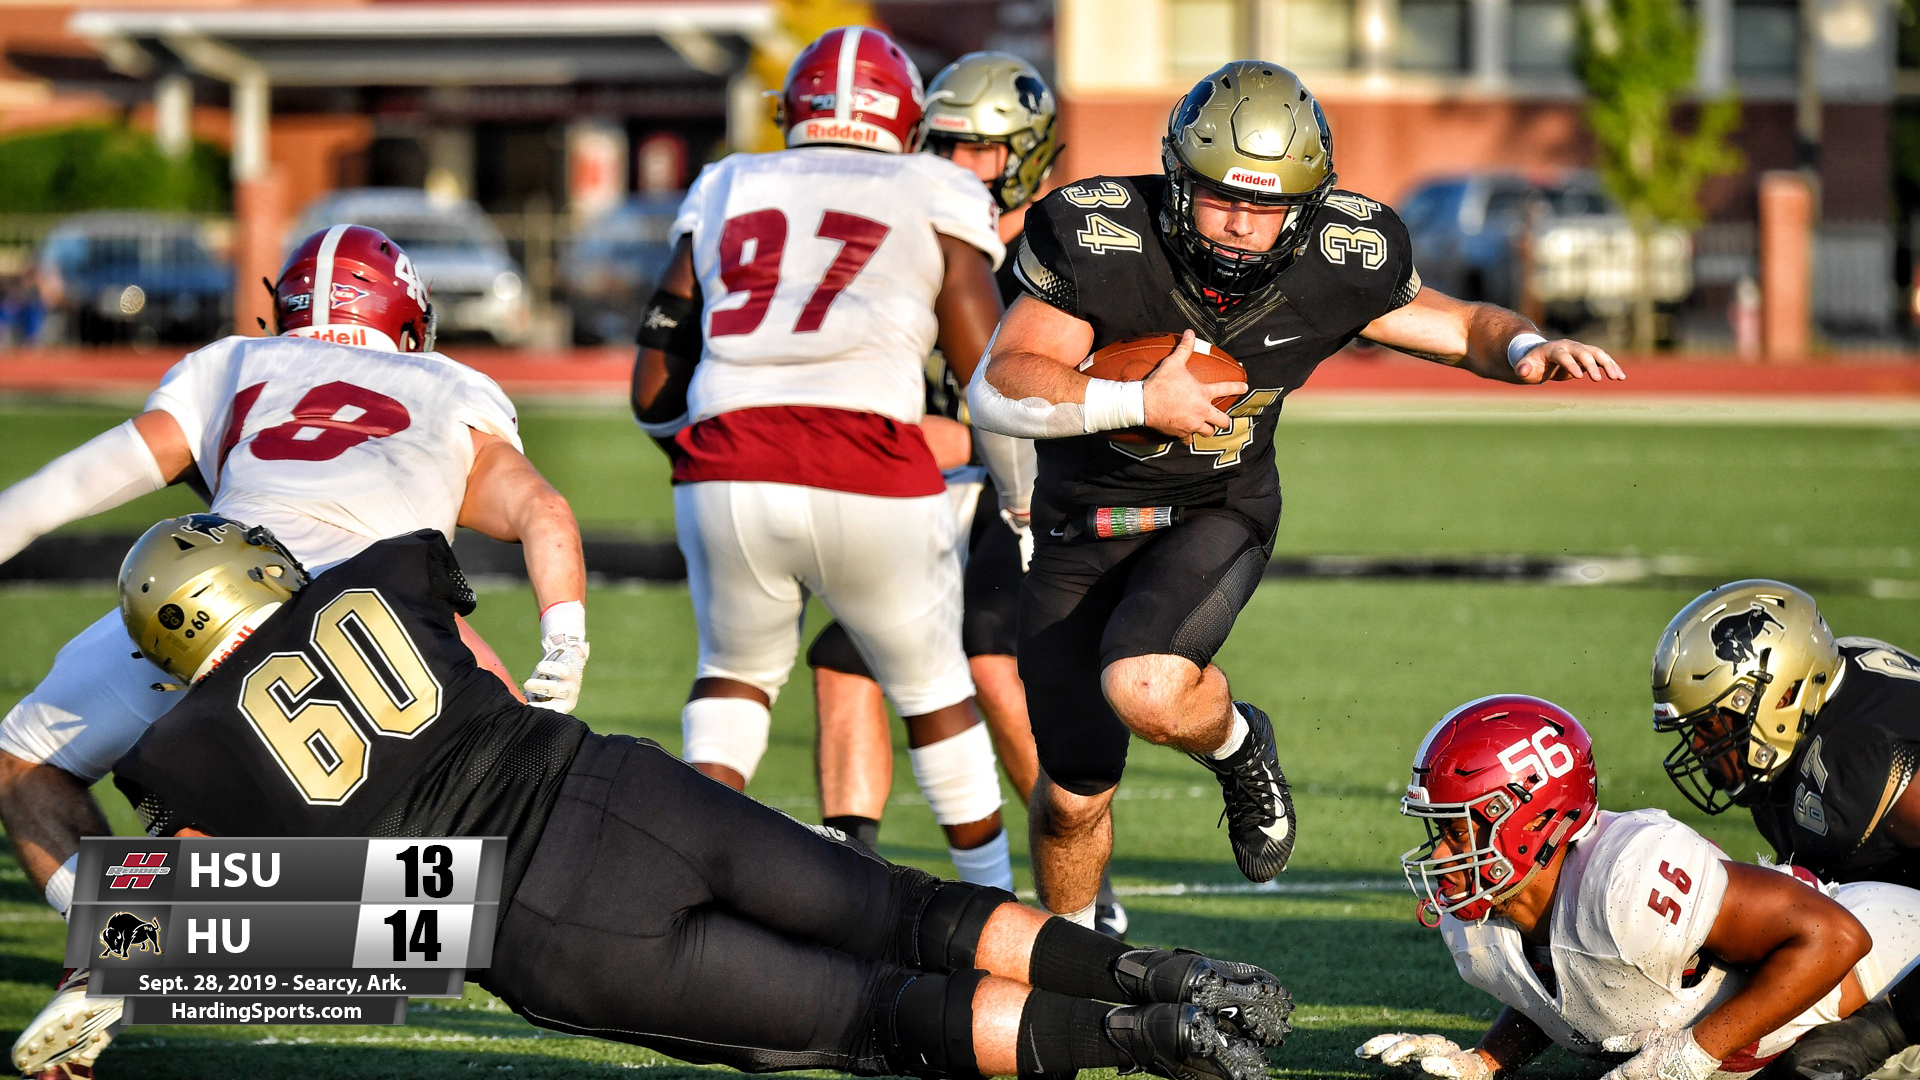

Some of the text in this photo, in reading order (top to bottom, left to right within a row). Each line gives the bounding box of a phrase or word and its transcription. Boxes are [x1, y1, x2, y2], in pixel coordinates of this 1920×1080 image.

[806, 124, 878, 144] Riddell
[1231, 173, 1276, 187] Riddell
[1061, 181, 1143, 255] 34
[1319, 191, 1388, 271] 34
[709, 208, 892, 338] 97
[1109, 386, 1285, 470] 4
[191, 610, 210, 631] 60
[237, 587, 443, 807] 60
[1496, 725, 1575, 793] 56
[1793, 734, 1829, 837] 67
[1647, 859, 1693, 926] 56
